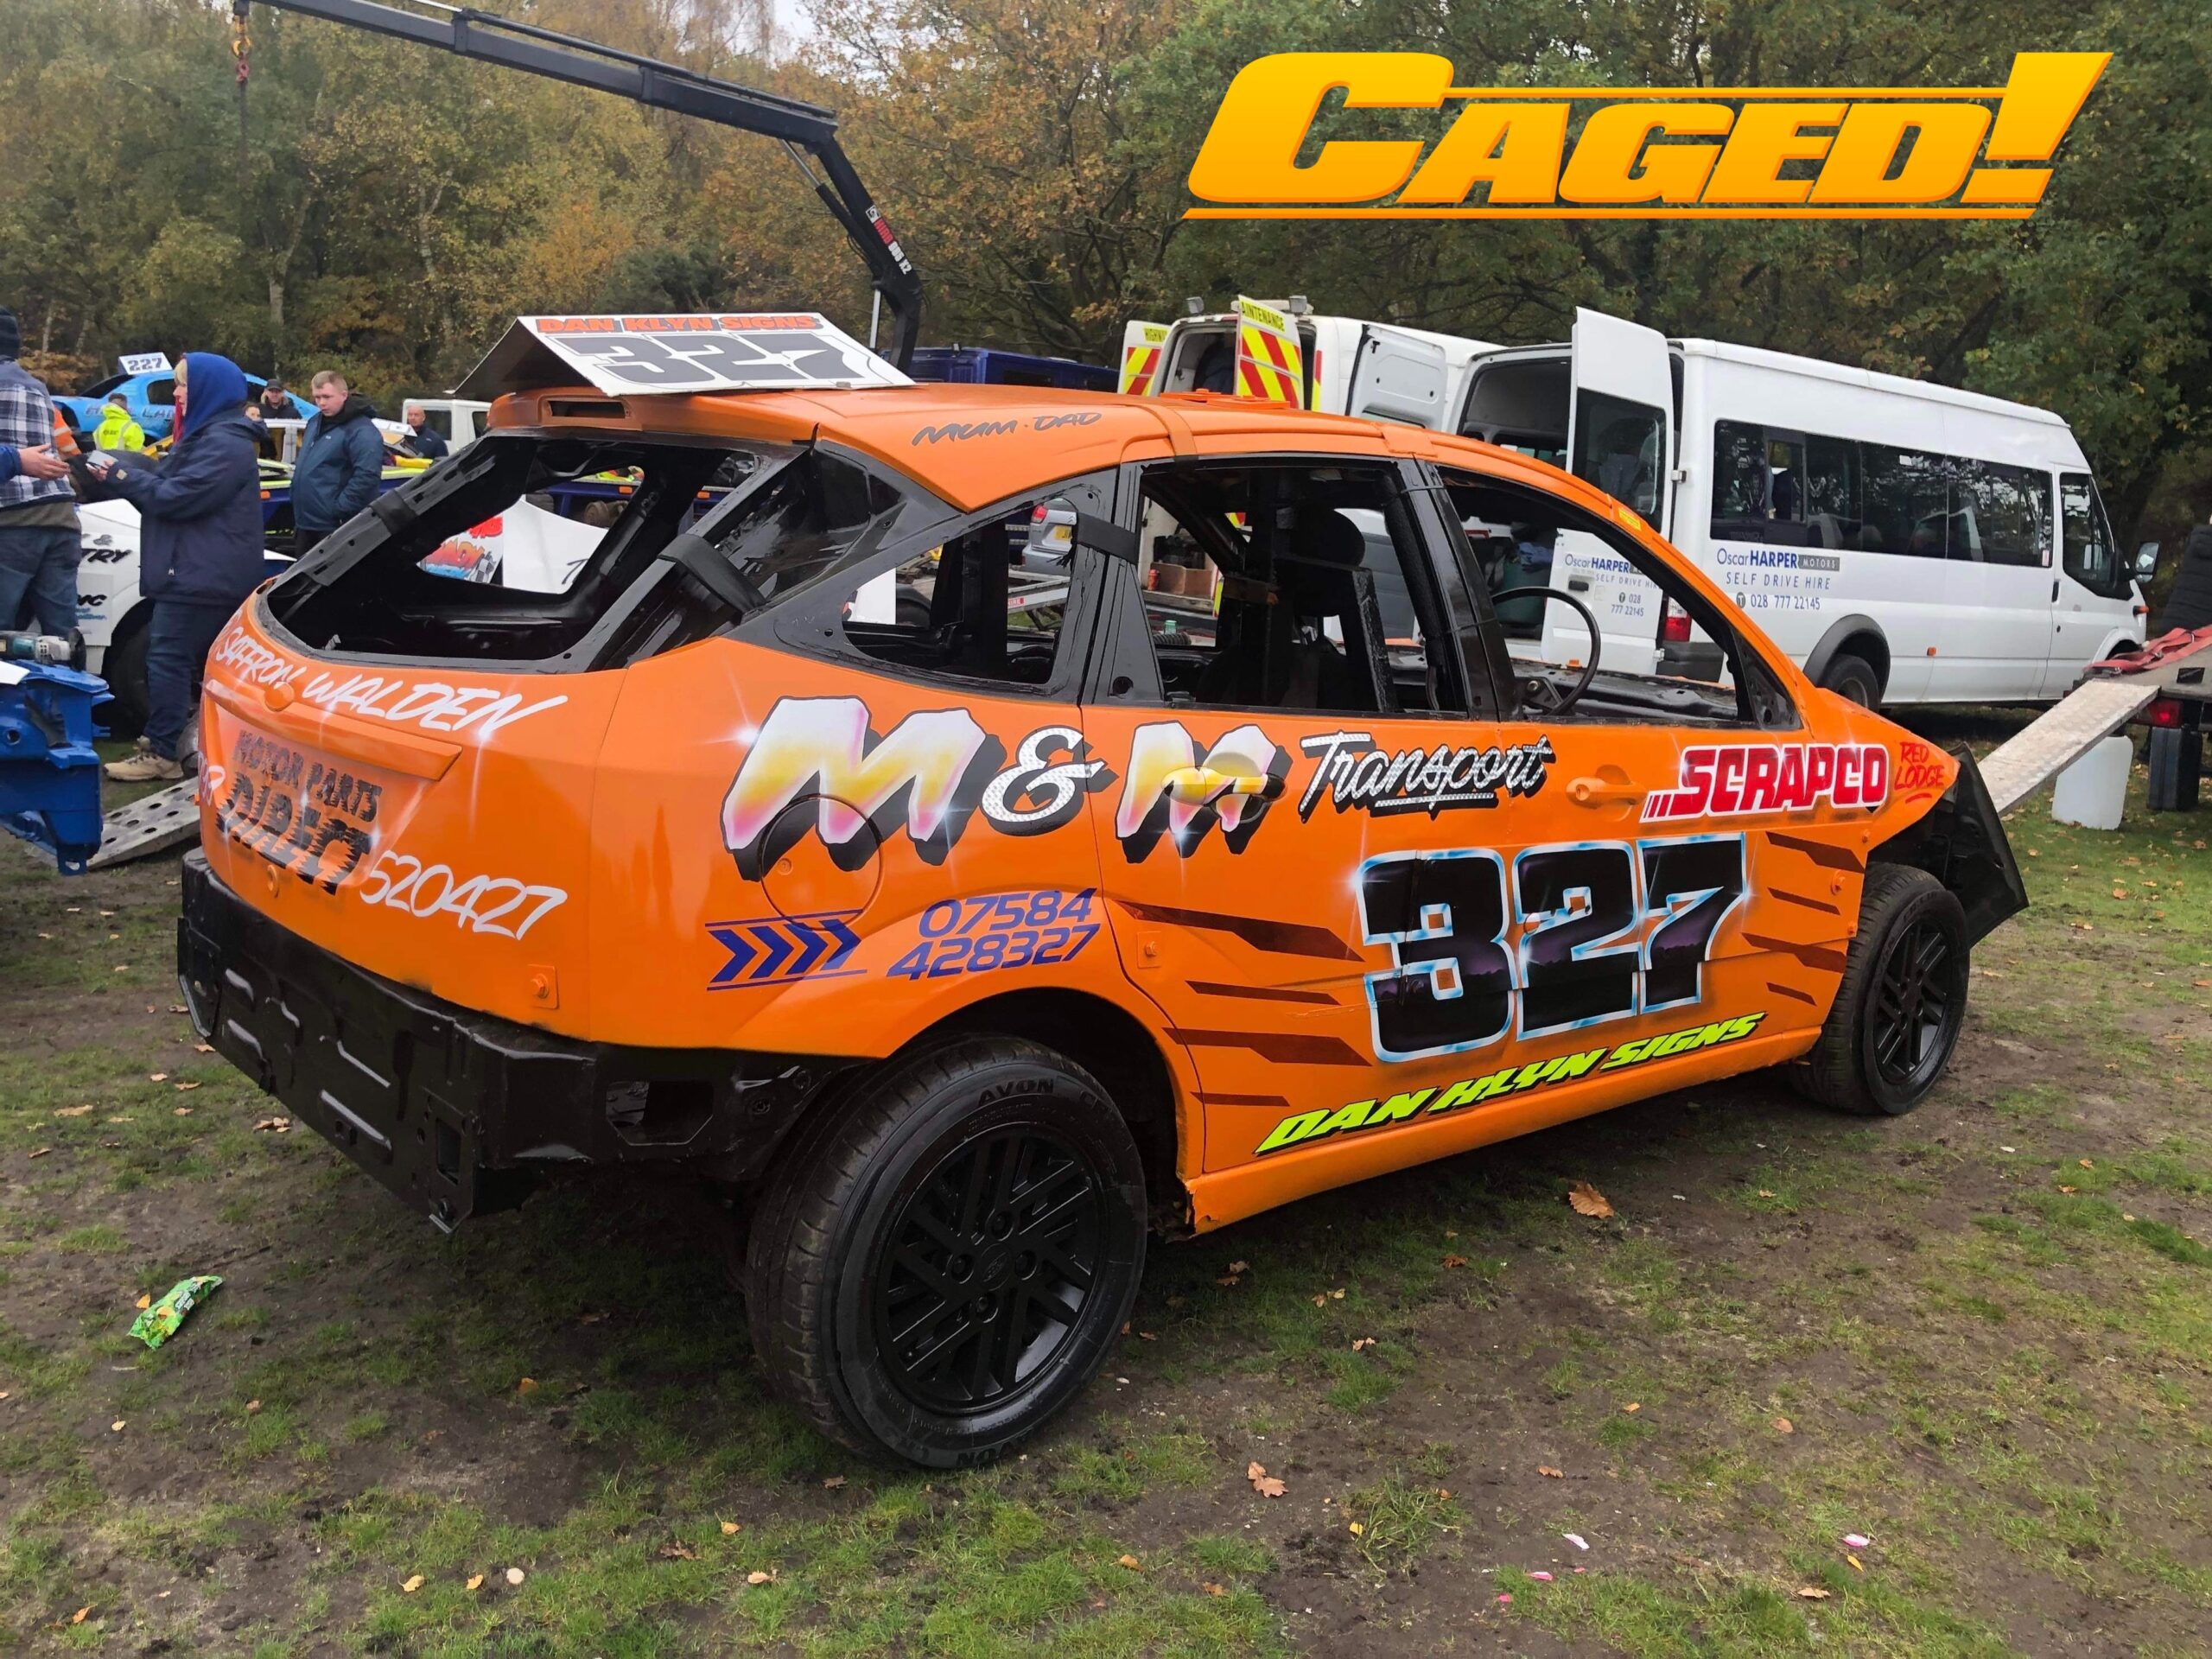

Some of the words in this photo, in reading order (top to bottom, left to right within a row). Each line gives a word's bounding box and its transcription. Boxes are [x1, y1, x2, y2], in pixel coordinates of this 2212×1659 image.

[537, 318, 617, 333] DAN
[624, 317, 719, 333] KLYN
[719, 315, 821, 330] SIGNS
[128, 357, 162, 372] 227
[550, 332, 867, 385] 327
[1033, 412, 1102, 430] DAD
[1750, 550, 1798, 569] HARPER
[1802, 558, 1836, 569] MOTORS
[1596, 574, 1615, 582] SELF
[1618, 578, 1642, 587] DRIVE
[1726, 572, 1757, 586] SELF
[1764, 574, 1799, 588] DRIVE
[1805, 576, 1831, 589] HIRE
[1611, 605, 1624, 614] 777
[1624, 606, 1644, 617] 22145
[1629, 594, 1641, 604] 028
[1751, 594, 1768, 607] 028
[1774, 594, 1791, 609] 777
[1795, 596, 1821, 610] 22145
[215, 626, 308, 689] SAFFRON
[302, 671, 568, 734] WALDEN
[1899, 741, 1929, 766] RED
[233, 730, 304, 789] MOTOR
[307, 762, 383, 822] PARTS
[721, 696, 998, 871] M
[982, 726, 1113, 831] &
[1116, 720, 1287, 855] M
[1299, 729, 1556, 821] Transport
[1661, 743, 1890, 819] SCRAPCO
[1894, 765, 1945, 790] LODGE
[215, 772, 376, 896] DIRECT
[359, 850, 569, 940] 520427
[918, 887, 1096, 938] 07584
[886, 923, 1101, 981] 428327
[1357, 832, 1749, 1064] 327
[978, 1078, 1055, 1103] AVON
[1253, 1087, 1440, 1156] DAN
[1599, 1011, 1767, 1071] SIGNS
